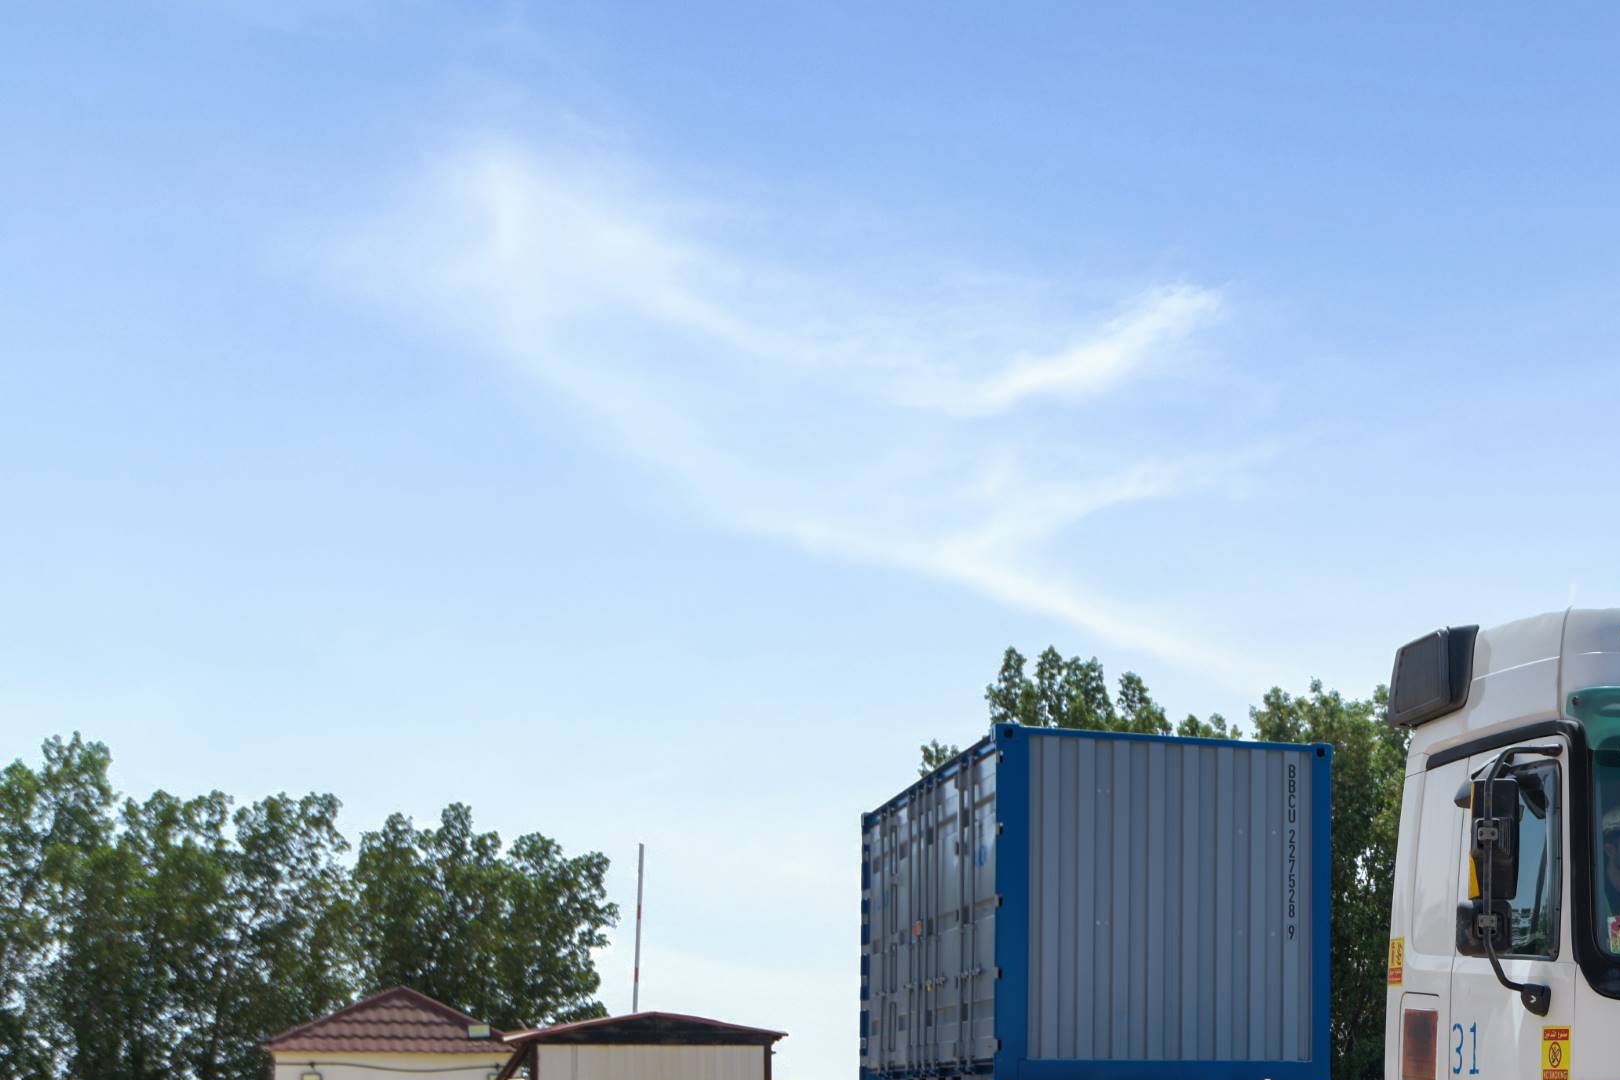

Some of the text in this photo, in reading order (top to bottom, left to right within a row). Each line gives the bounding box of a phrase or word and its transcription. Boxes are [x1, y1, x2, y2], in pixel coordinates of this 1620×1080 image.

[1288, 764, 1296, 940] BBCU 227528 9
[1452, 1022, 1480, 1074] 31
